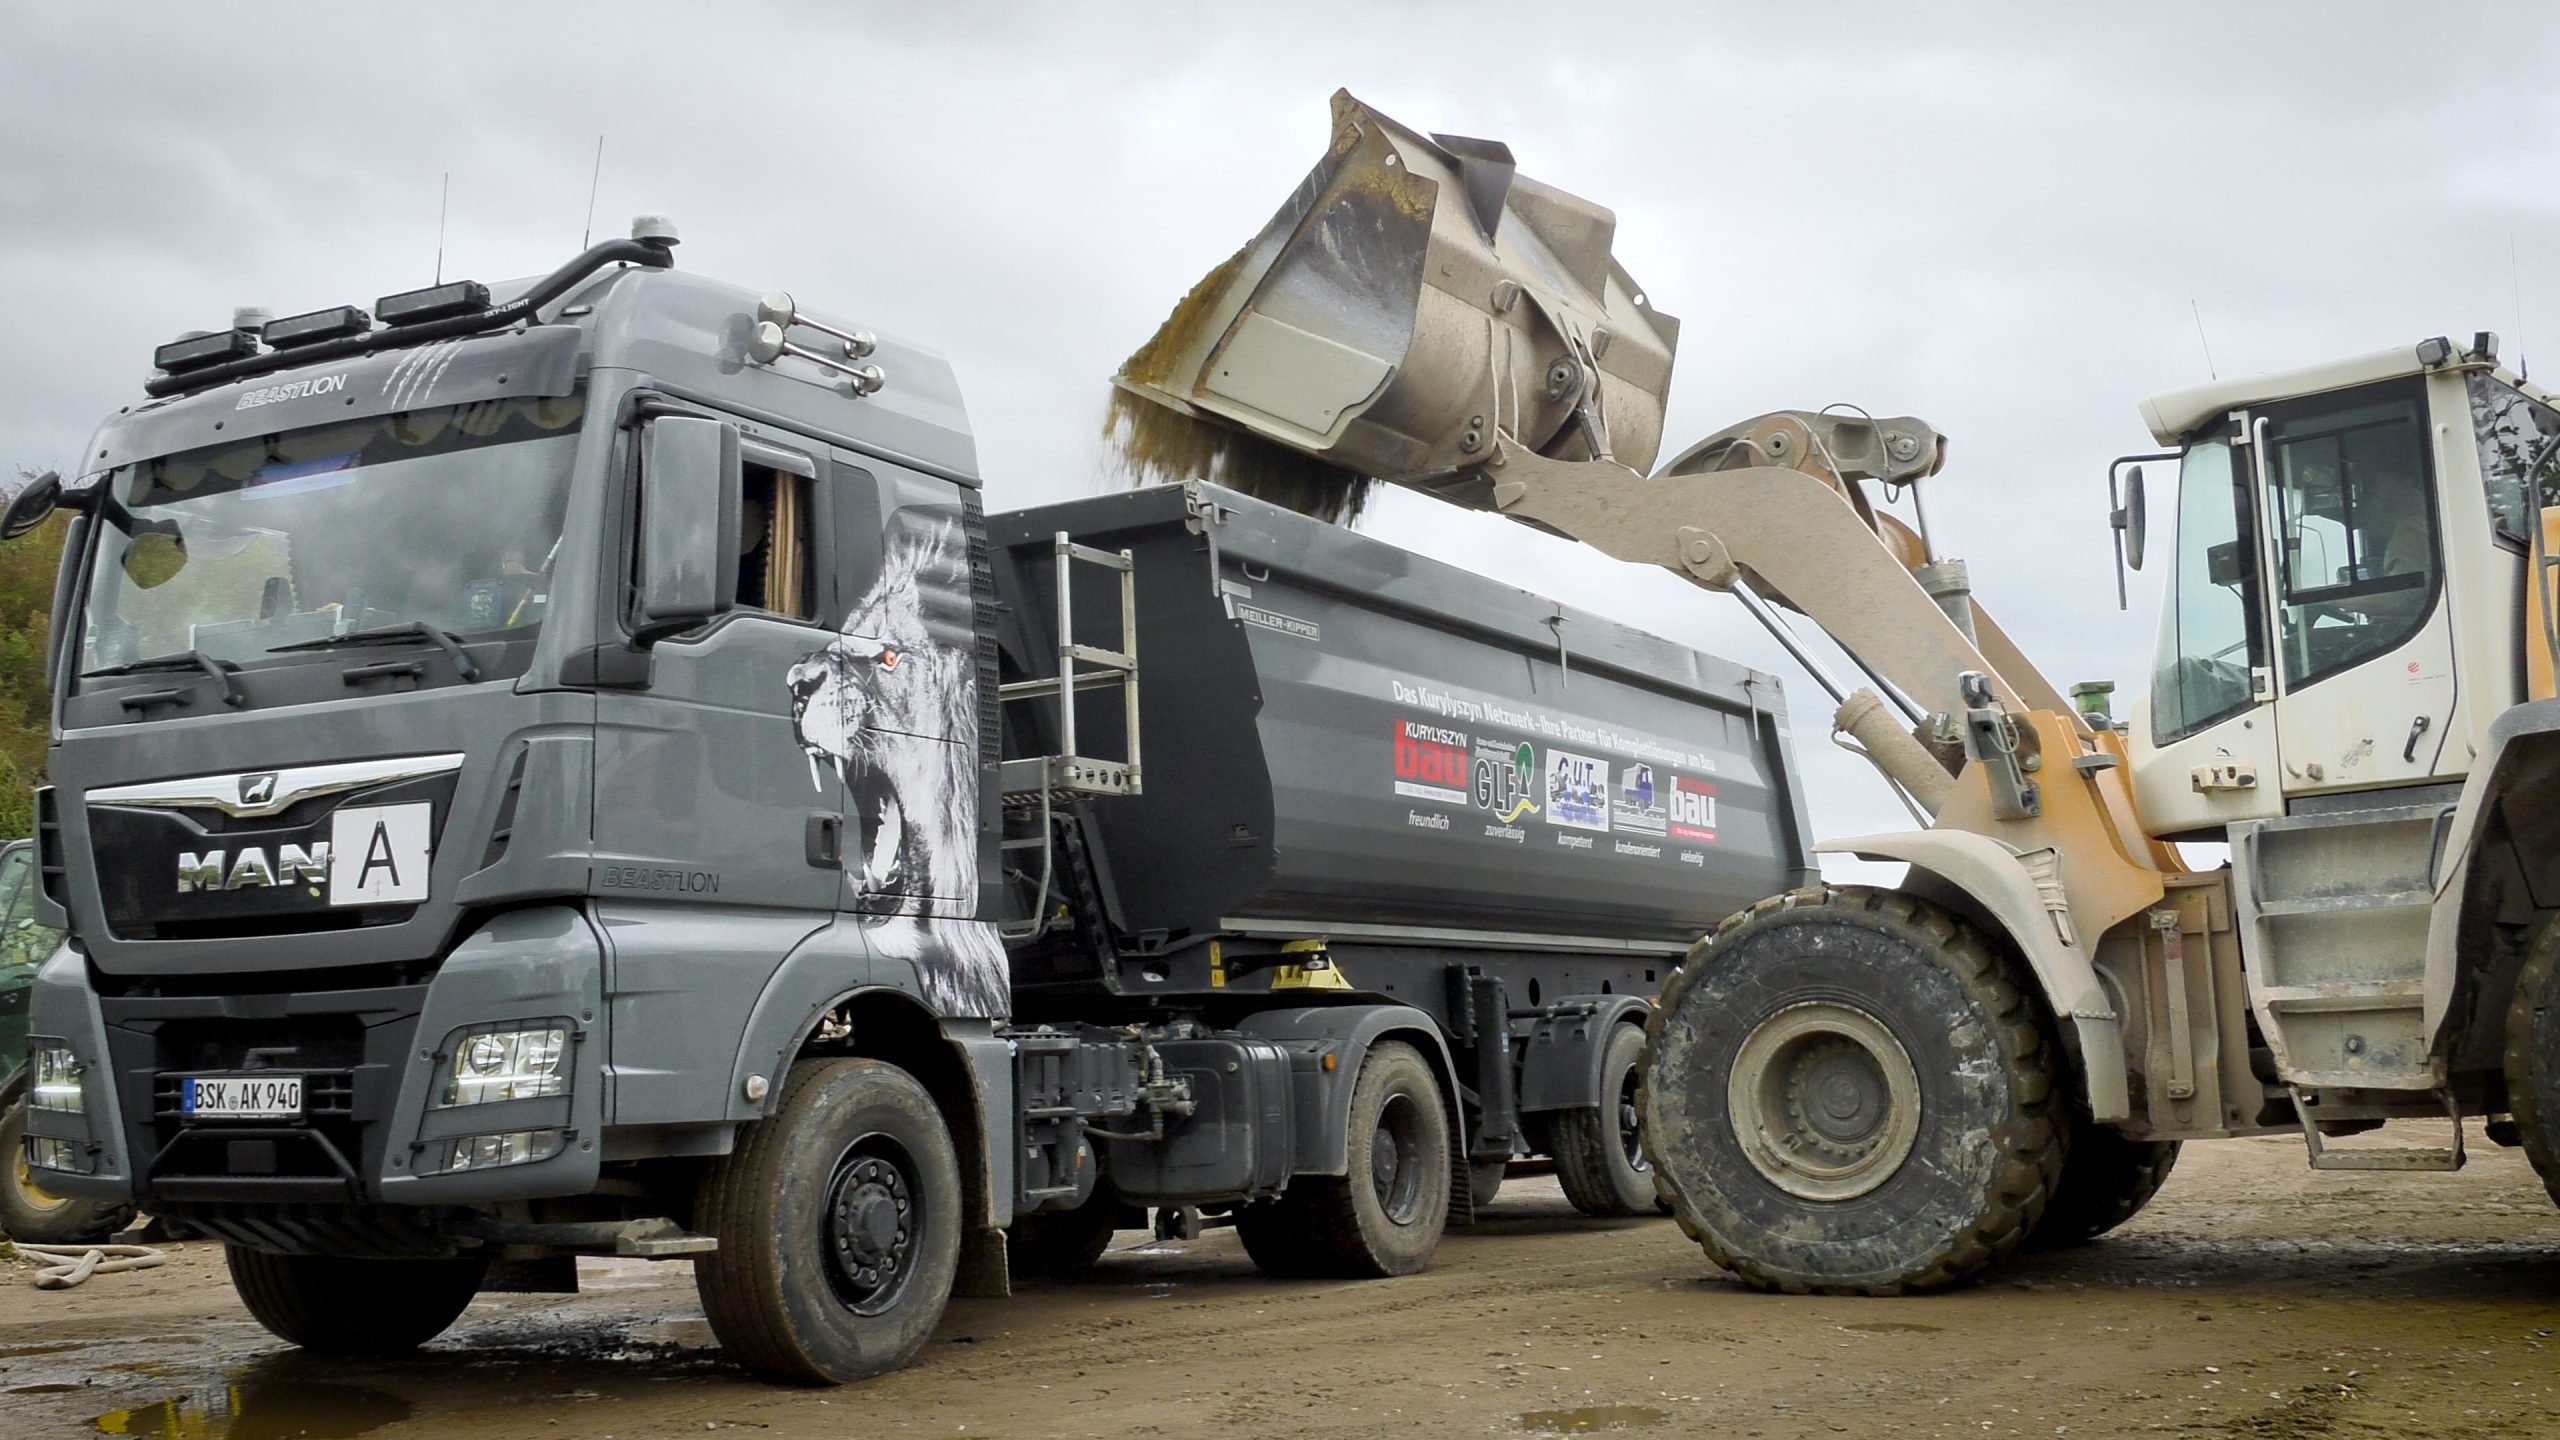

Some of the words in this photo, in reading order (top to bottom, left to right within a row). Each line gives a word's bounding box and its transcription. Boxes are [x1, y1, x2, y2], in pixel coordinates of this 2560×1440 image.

[484, 298, 530, 319] SKY-LIGHT
[235, 373, 348, 411] BEASTLION
[1240, 607, 1318, 637] MEILLER-KIPPER
[1392, 680, 1418, 705] Das
[1418, 686, 1483, 723] Kurylyszyn
[1483, 702, 1536, 732] Netzwerk
[1561, 721, 1597, 745] Partner
[1598, 728, 1613, 749] für
[1404, 721, 1468, 748] KURYLYSZYN
[1394, 719, 1467, 788] bau
[1670, 775, 1716, 828] bau
[1408, 809, 1450, 831] freundlich
[1484, 824, 1525, 843] zuverlässig
[357, 820, 401, 889] A
[1557, 831, 1593, 850] kompetent
[178, 841, 330, 893] MAN
[601, 866, 720, 893] BEASTLION
[195, 1082, 227, 1109] BSK
[240, 1083, 262, 1109] AK
[267, 1082, 299, 1109] 940
